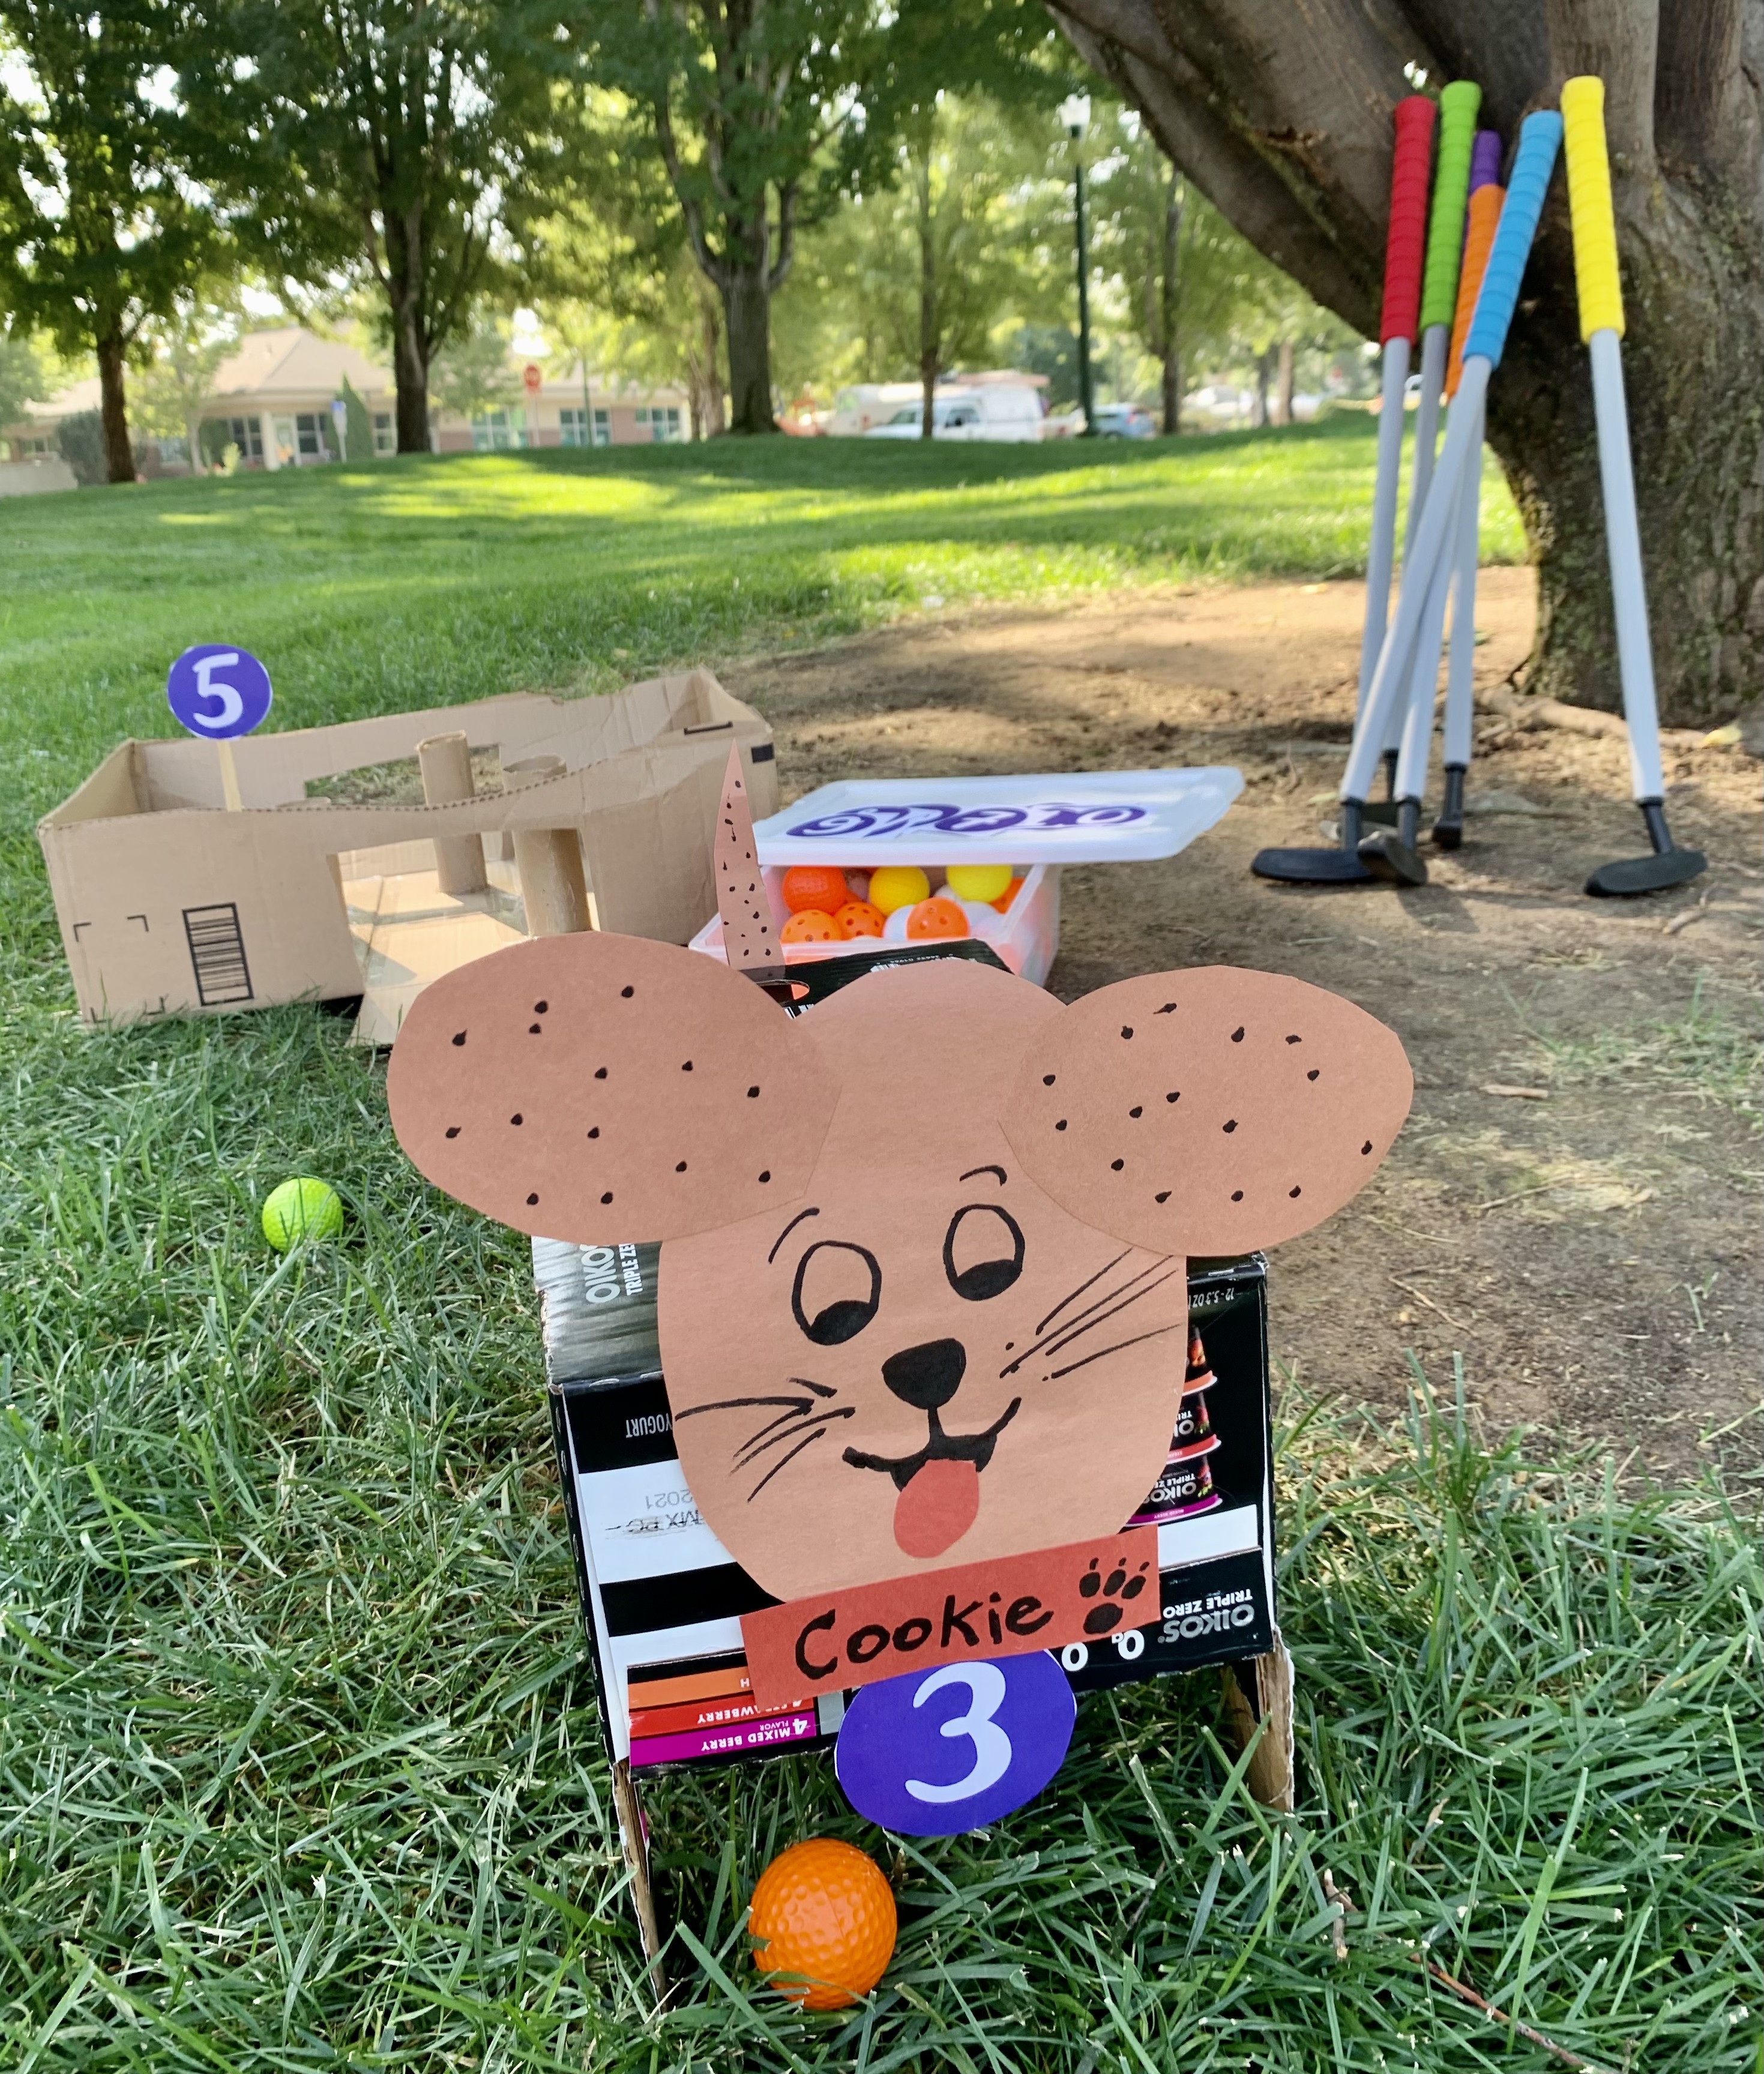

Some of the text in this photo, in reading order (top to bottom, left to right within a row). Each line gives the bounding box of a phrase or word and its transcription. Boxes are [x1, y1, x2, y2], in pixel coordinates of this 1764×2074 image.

[193, 652, 244, 729] 5
[621, 1259, 643, 1296] TRIPLE
[625, 1413, 672, 1438] YOGURT
[1166, 1473, 1196, 1486] TRIPLE
[646, 1489, 693, 1509] 2021
[1163, 1589, 1253, 1619] TRIPLE ZERO
[795, 1592, 1055, 1680] Cookie
[701, 1718, 808, 1751] 4 MIXED BERRY
[759, 1720, 789, 1731] FLAVOR
[905, 1661, 1013, 1803] 3
